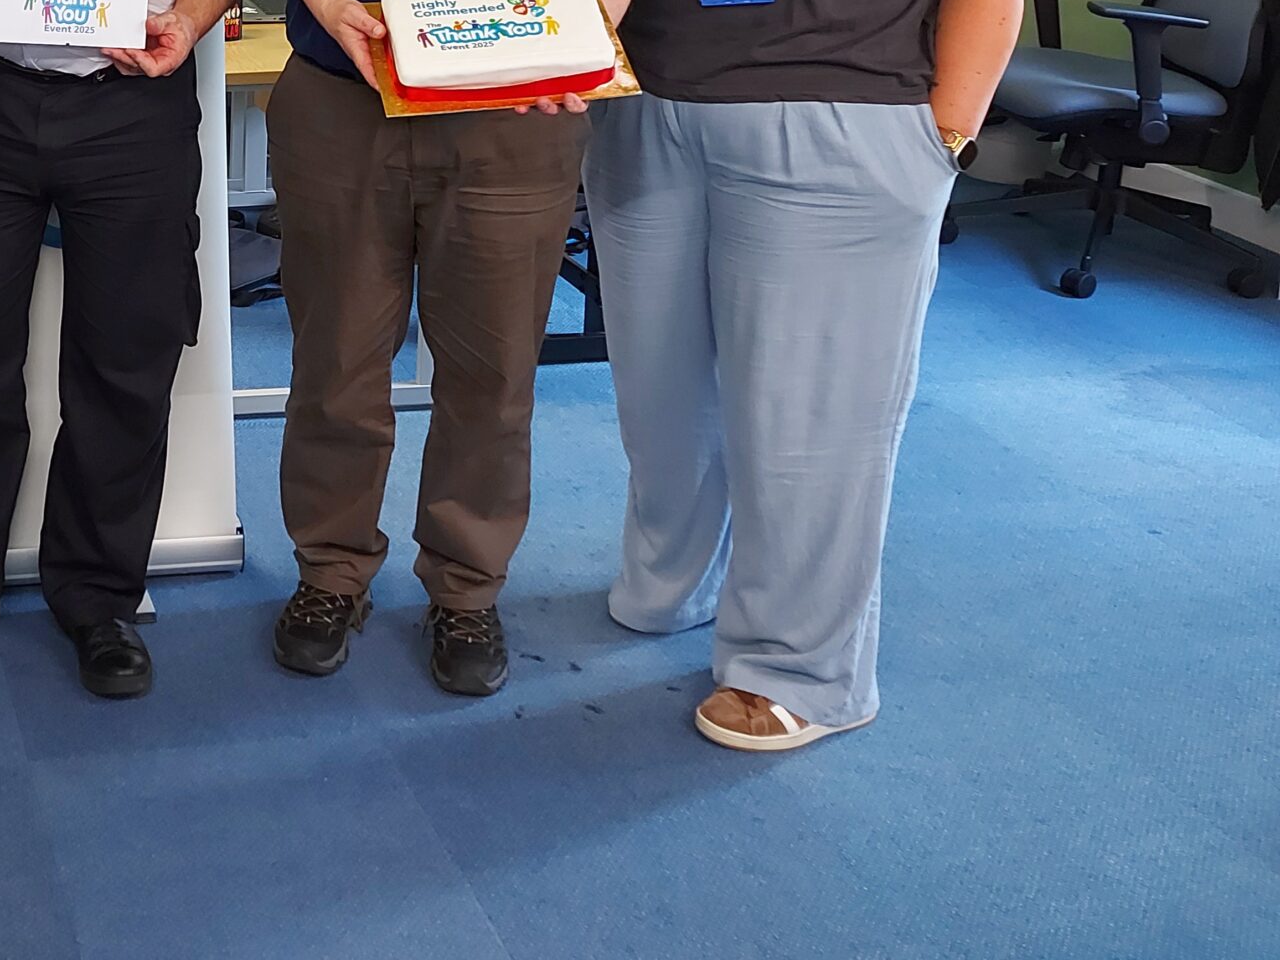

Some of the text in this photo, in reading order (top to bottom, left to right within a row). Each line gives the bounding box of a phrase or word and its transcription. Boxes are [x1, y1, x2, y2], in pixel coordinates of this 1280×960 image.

[411, 0, 457, 10] Highly
[414, 3, 506, 18] Commended
[54, 6, 87, 22] You
[44, 25, 95, 34] Event 2025
[433, 22, 542, 42] Thank You
[472, 41, 495, 49] 2025
